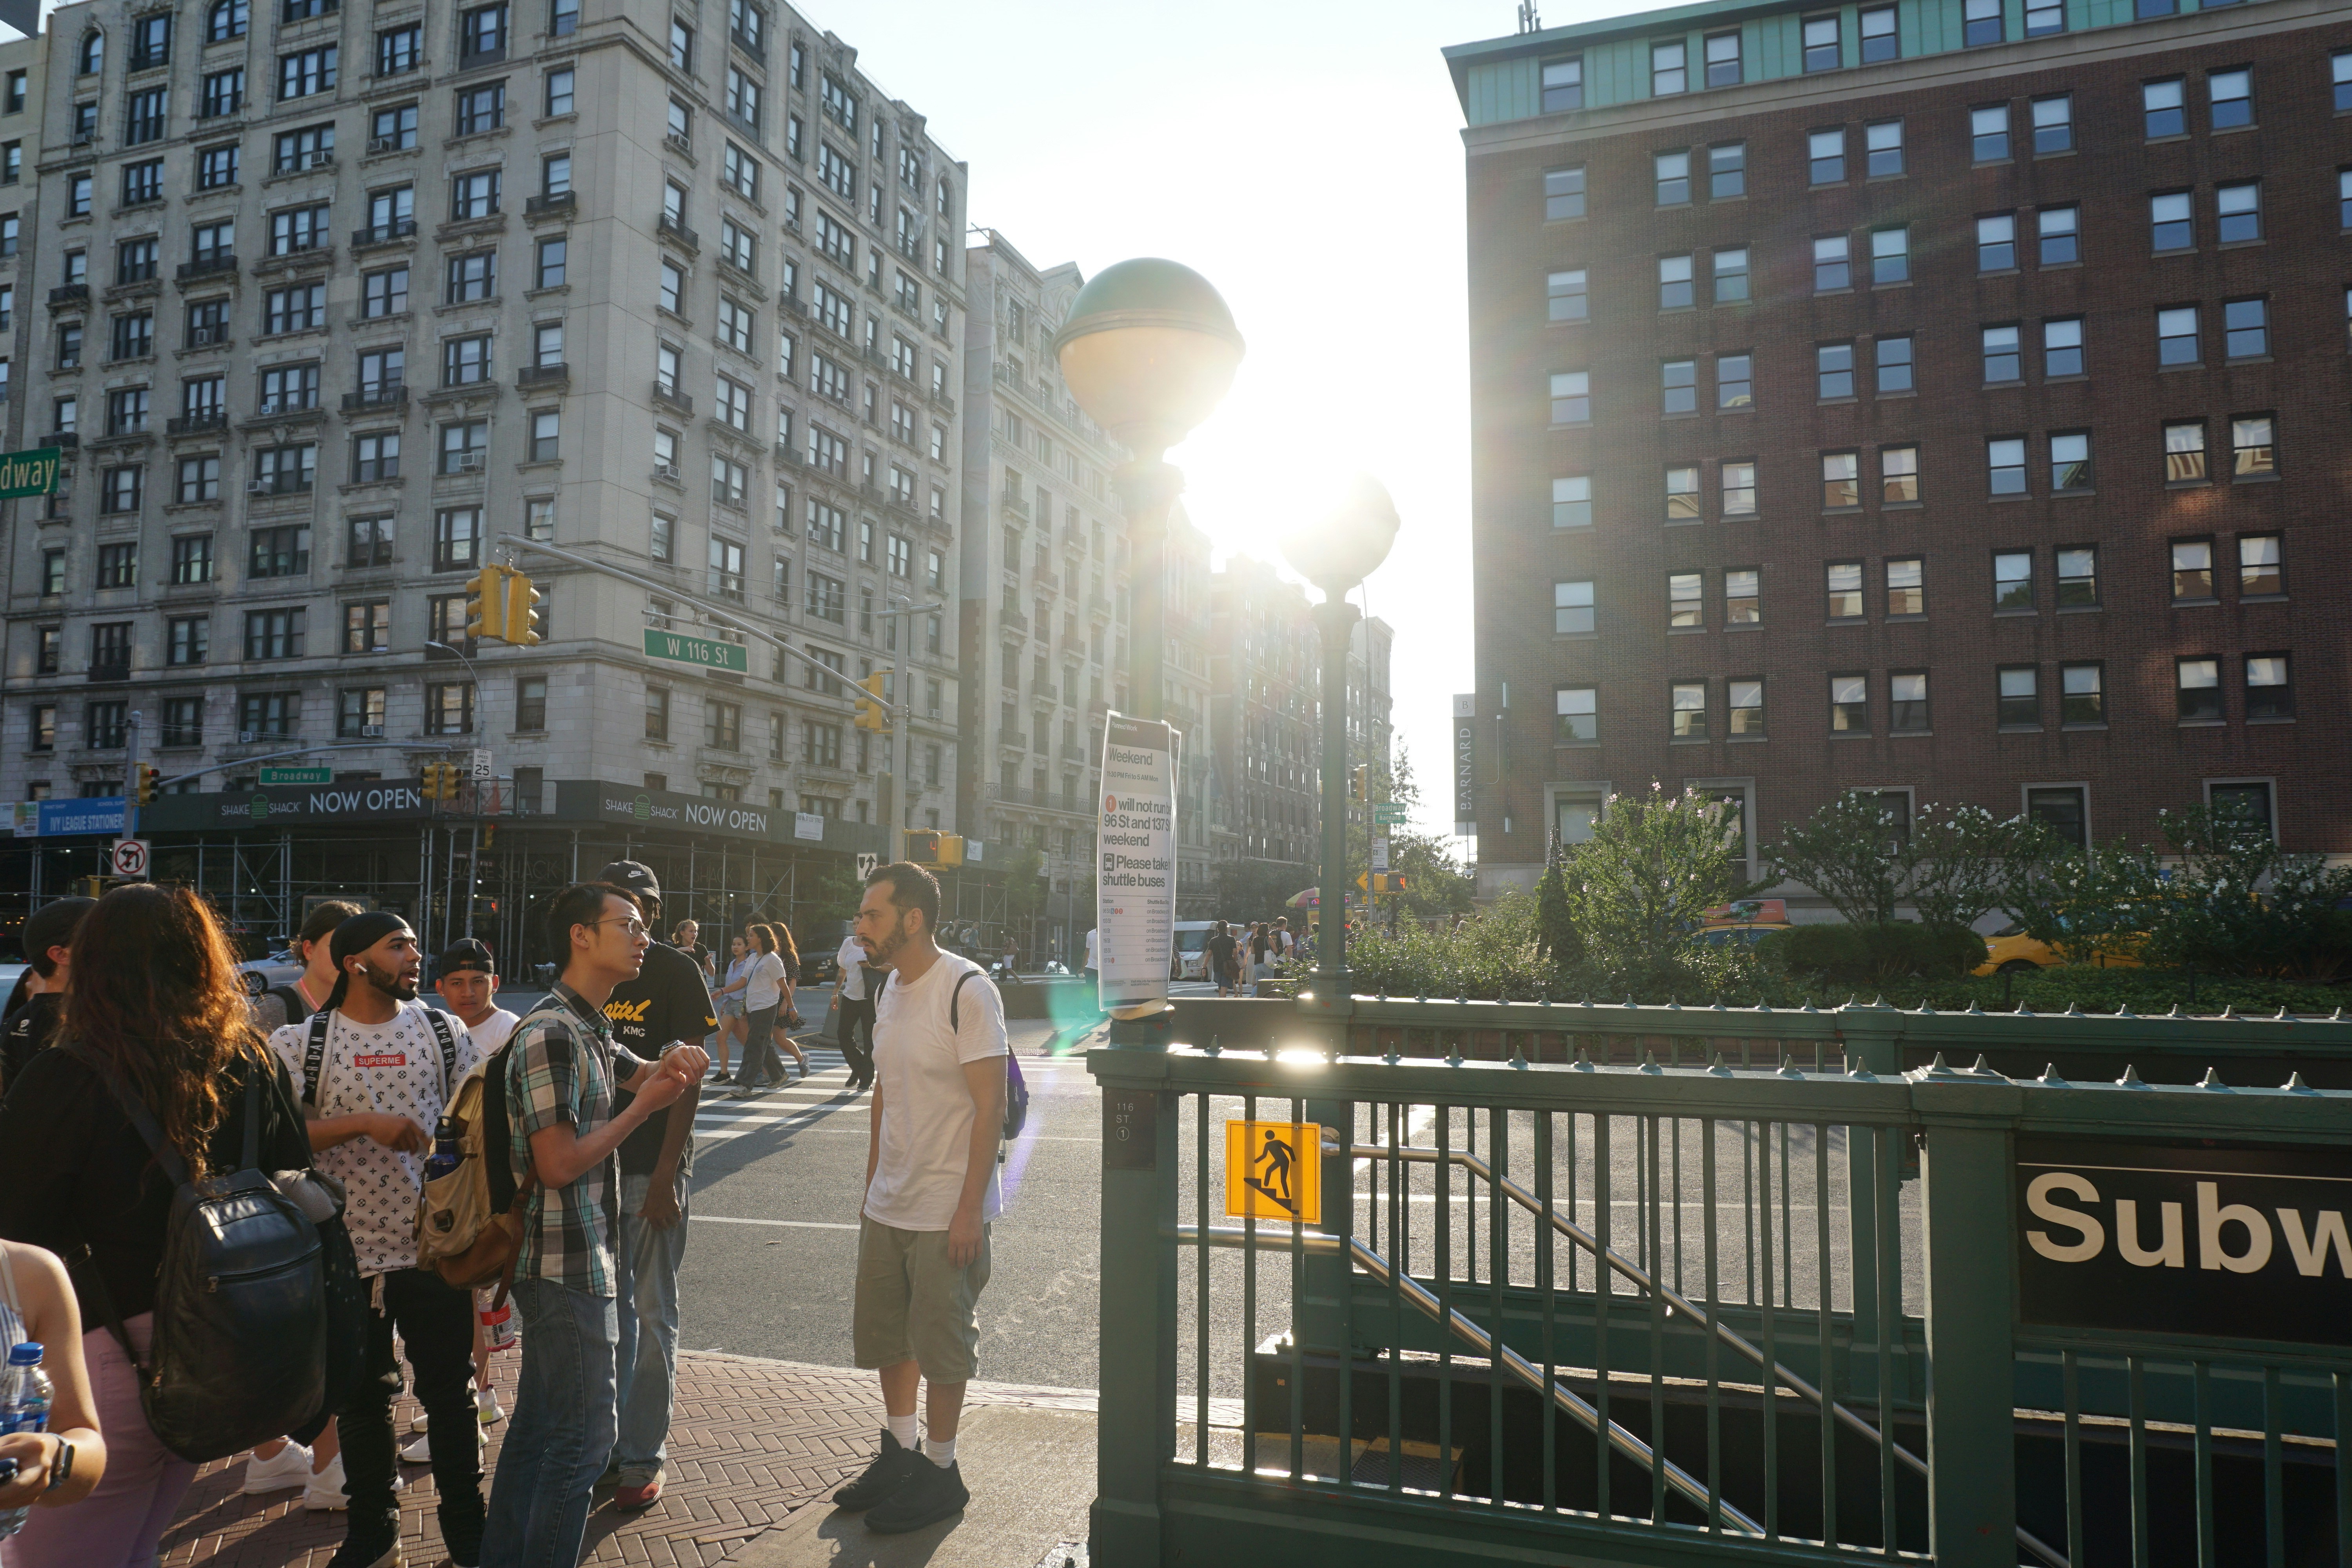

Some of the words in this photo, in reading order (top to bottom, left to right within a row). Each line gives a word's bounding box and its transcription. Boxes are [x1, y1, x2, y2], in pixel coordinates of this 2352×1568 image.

[1, 457, 55, 493] dway
[667, 637, 680, 656] W
[688, 641, 708, 661] 116
[715, 647, 728, 665] St
[1111, 721, 1126, 730] Planned
[1109, 747, 1153, 766] Weekend
[271, 771, 321, 781] Broadway
[475, 764, 490, 776] 25
[1459, 728, 1471, 810] BARNARD
[221, 804, 250, 815] SHAKE
[269, 802, 300, 813] SHACK
[310, 791, 361, 813] NOW
[367, 788, 421, 810] OPEN
[1109, 799, 1112, 809] 1
[1118, 798, 1134, 811] will
[1136, 800, 1152, 812] not
[1154, 803, 1166, 814] run
[62, 815, 87, 831] LEAGUE
[605, 799, 633, 813] SHAKE
[651, 806, 677, 819] SHACK
[686, 803, 726, 826] NOW
[729, 809, 766, 833] OPEN
[1104, 814, 1117, 827] 96
[1118, 815, 1130, 828] St
[1131, 817, 1151, 829] and
[1152, 818, 1165, 830] 137
[1103, 832, 1149, 846] weekend
[499, 860, 558, 879] SHACK
[1116, 855, 1151, 869] Please
[1152, 857, 1168, 870] take
[1103, 872, 1136, 886] shuttle
[1138, 873, 1165, 887] buses
[1400, 877, 1405, 889] 4
[623, 1025, 646, 1037] KMG
[359, 1057, 401, 1065] SUPERME
[1117, 1103, 1133, 1111] 116
[1116, 1114, 1132, 1123] ST.
